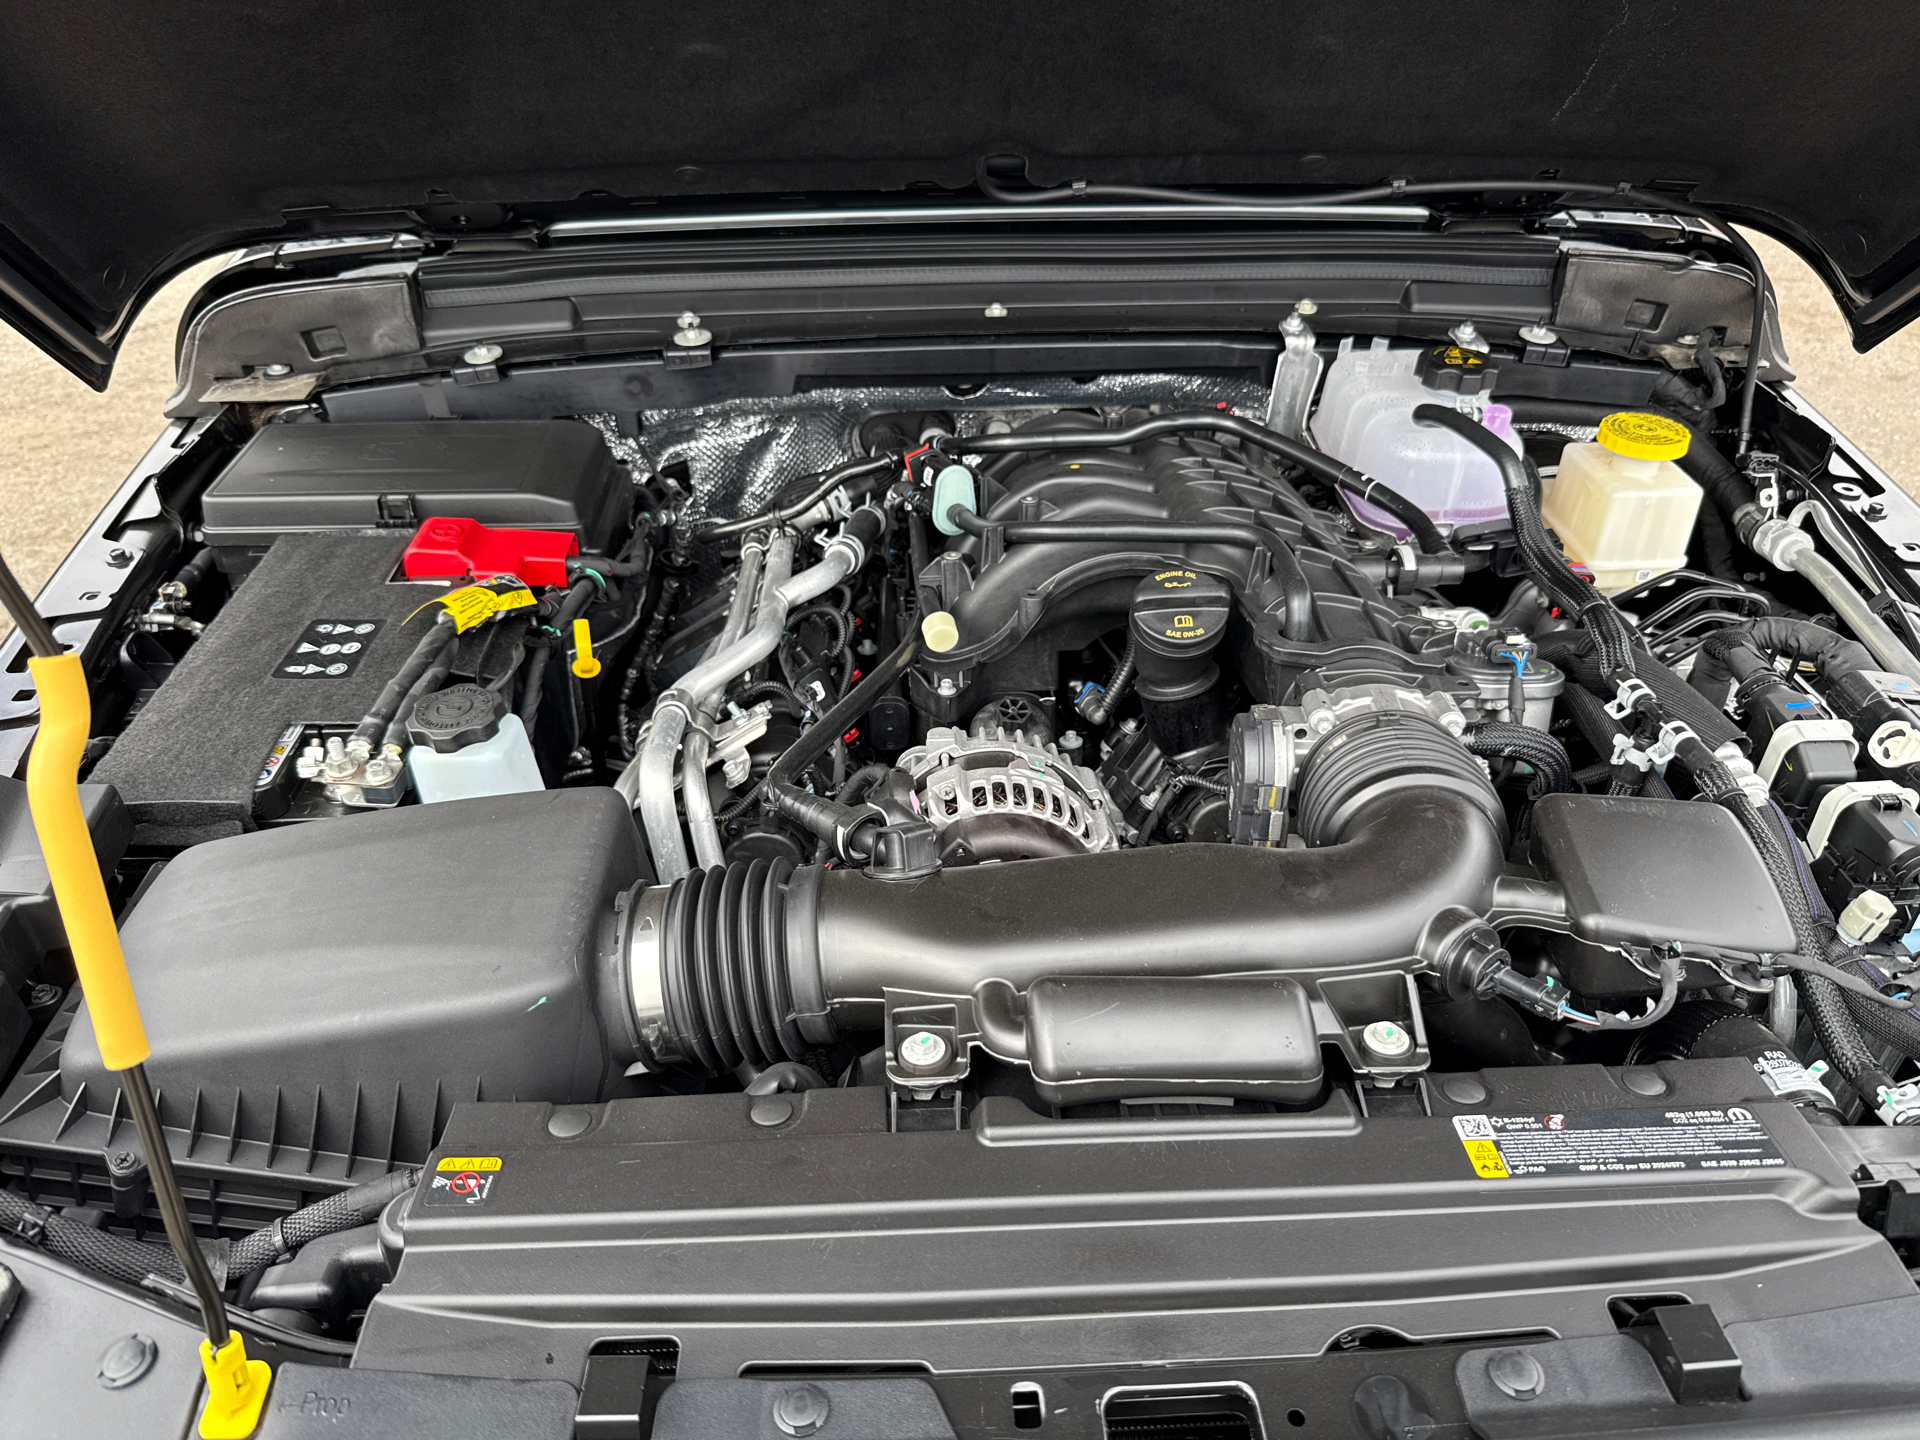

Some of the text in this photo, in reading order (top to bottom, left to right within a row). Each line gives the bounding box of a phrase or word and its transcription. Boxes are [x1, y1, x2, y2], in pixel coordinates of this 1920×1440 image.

[1154, 570, 1197, 581] ENGINE OIL
[1165, 629, 1182, 638] SAE
[1763, 1050, 1787, 1059] RAD
[300, 1390, 351, 1424] Prop
